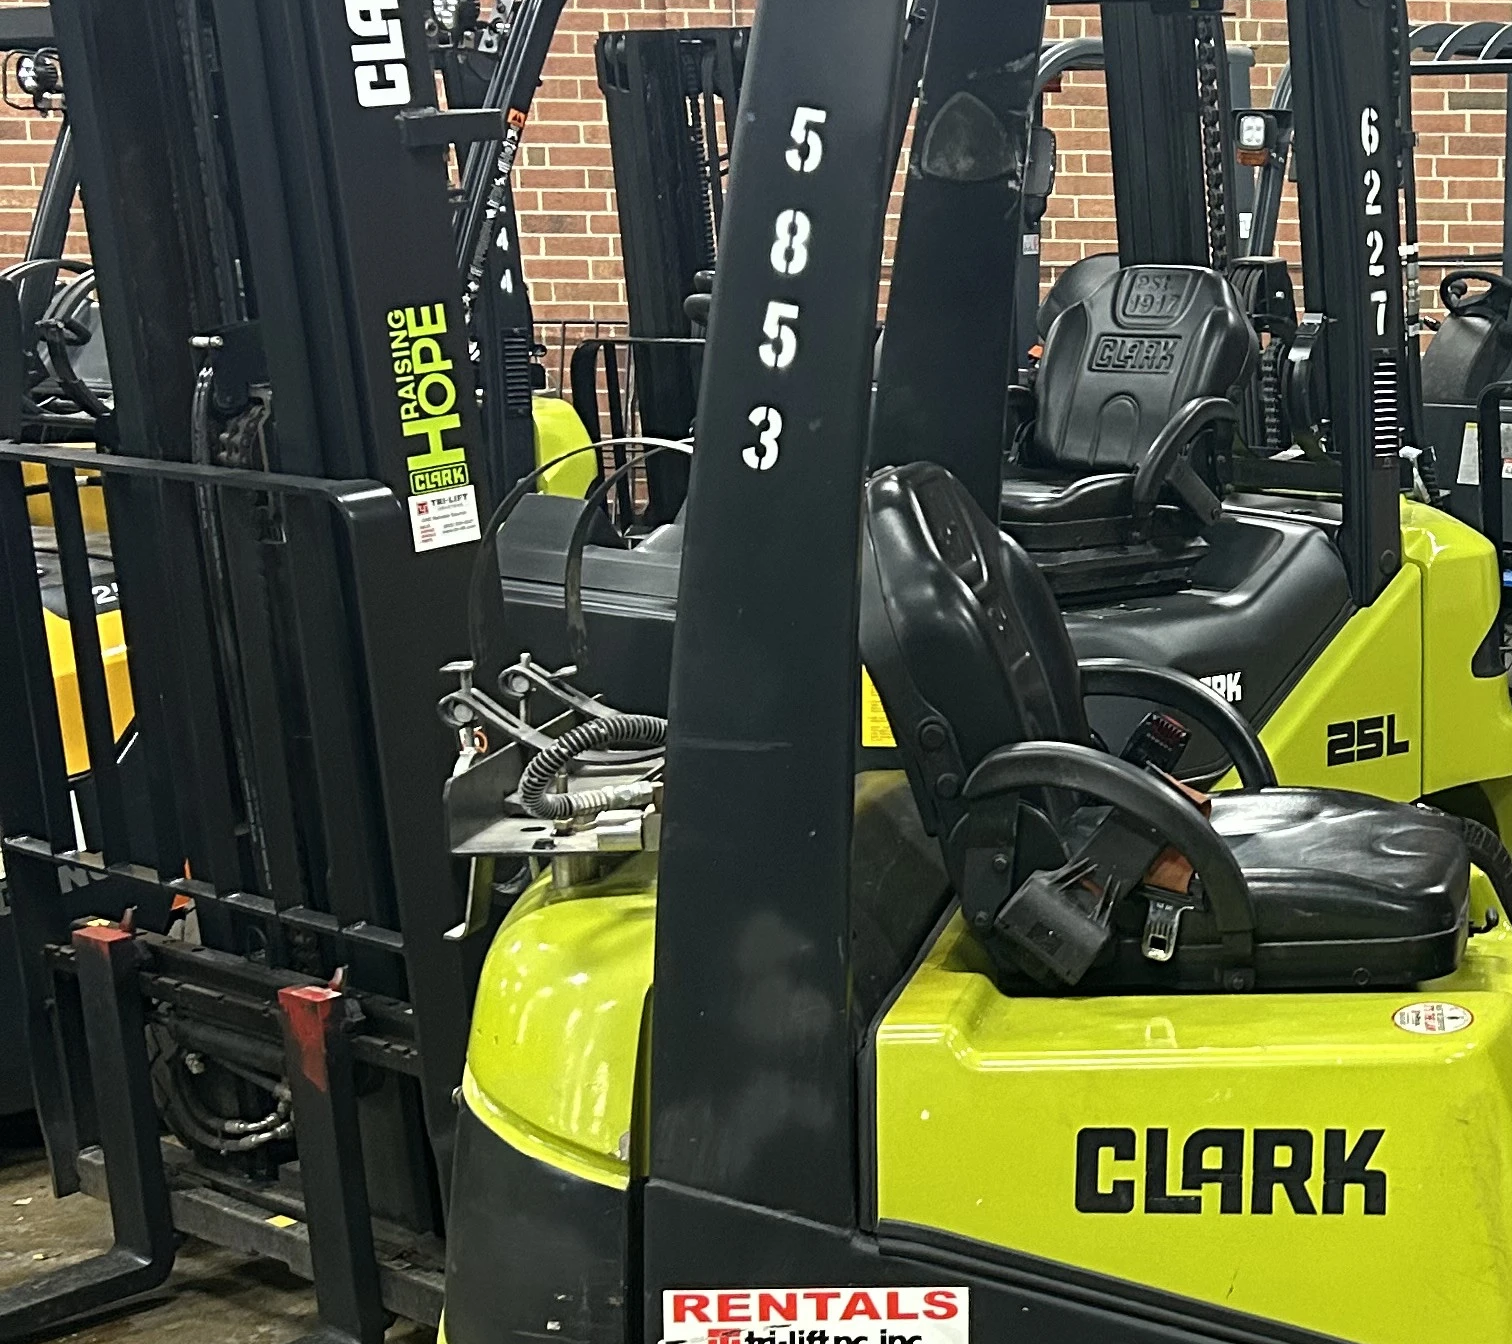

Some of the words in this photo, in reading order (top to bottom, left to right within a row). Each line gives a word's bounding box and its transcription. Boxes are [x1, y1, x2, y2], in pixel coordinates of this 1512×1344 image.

[387, 309, 420, 420] RAISING
[1093, 337, 1178, 371] CLARK
[402, 303, 467, 471] HOPE
[413, 466, 465, 491] CLARK
[1327, 714, 1410, 767] 25L
[1075, 1127, 1387, 1216] CLARK
[673, 1290, 959, 1323] RENTALS
